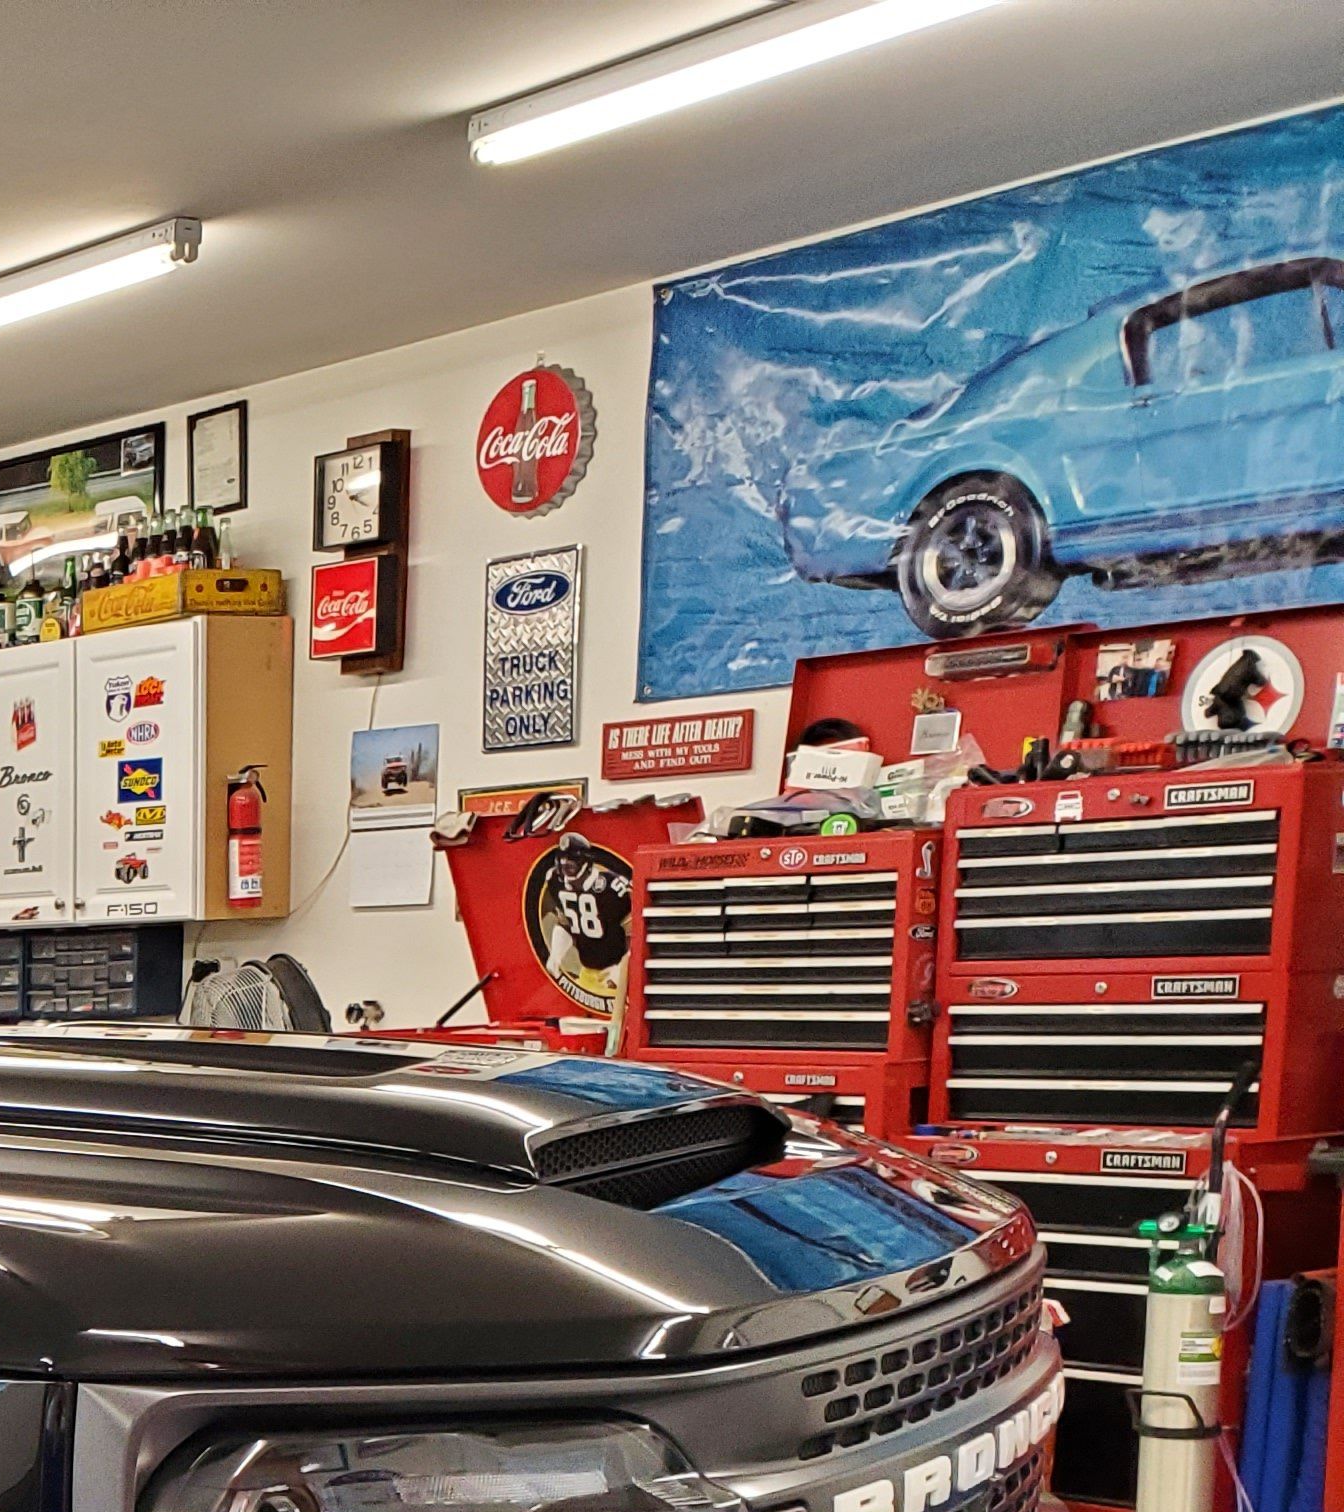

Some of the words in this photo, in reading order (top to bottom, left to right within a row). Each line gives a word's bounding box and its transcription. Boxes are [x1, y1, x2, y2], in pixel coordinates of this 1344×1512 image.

[341, 463, 349, 476] 11
[353, 455, 364, 469] 12
[332, 478, 344, 493] 10
[327, 496, 336, 510] 9
[331, 512, 340, 526] 8
[364, 519, 373, 533] 5
[339, 524, 348, 537] 7
[351, 526, 361, 540] 6
[507, 576, 557, 609] Ford
[499, 650, 559, 676] TRUCK
[489, 679, 569, 708] PARKING
[505, 712, 552, 737] ONLY
[131, 723, 155, 742] NHRA
[608, 728, 621, 750] IS
[622, 725, 651, 748] THERE
[651, 723, 672, 745] LIFE
[672, 720, 703, 744] AFTER
[703, 716, 744, 741] DEATH?
[621, 749, 644, 761] MESS
[648, 748, 672, 758] WITH
[676, 746, 690, 756] MY
[693, 743, 720, 754] TOOLS
[633, 760, 655, 770] AND
[660, 757, 686, 768] FIND
[689, 755, 711, 765] OUT!
[122, 775, 158, 788] SUNOCO
[1170, 786, 1248, 804] CRAFTSMAN
[487, 801, 512, 813] ICE
[783, 849, 803, 867] STP
[813, 852, 866, 865] CRAFTSMAN
[558, 891, 603, 938] 58
[1156, 979, 1234, 994] CRAFTSMAN
[785, 1074, 836, 1086] CRAFTSMAN
[1105, 1153, 1181, 1169] CRAFTSMAN
